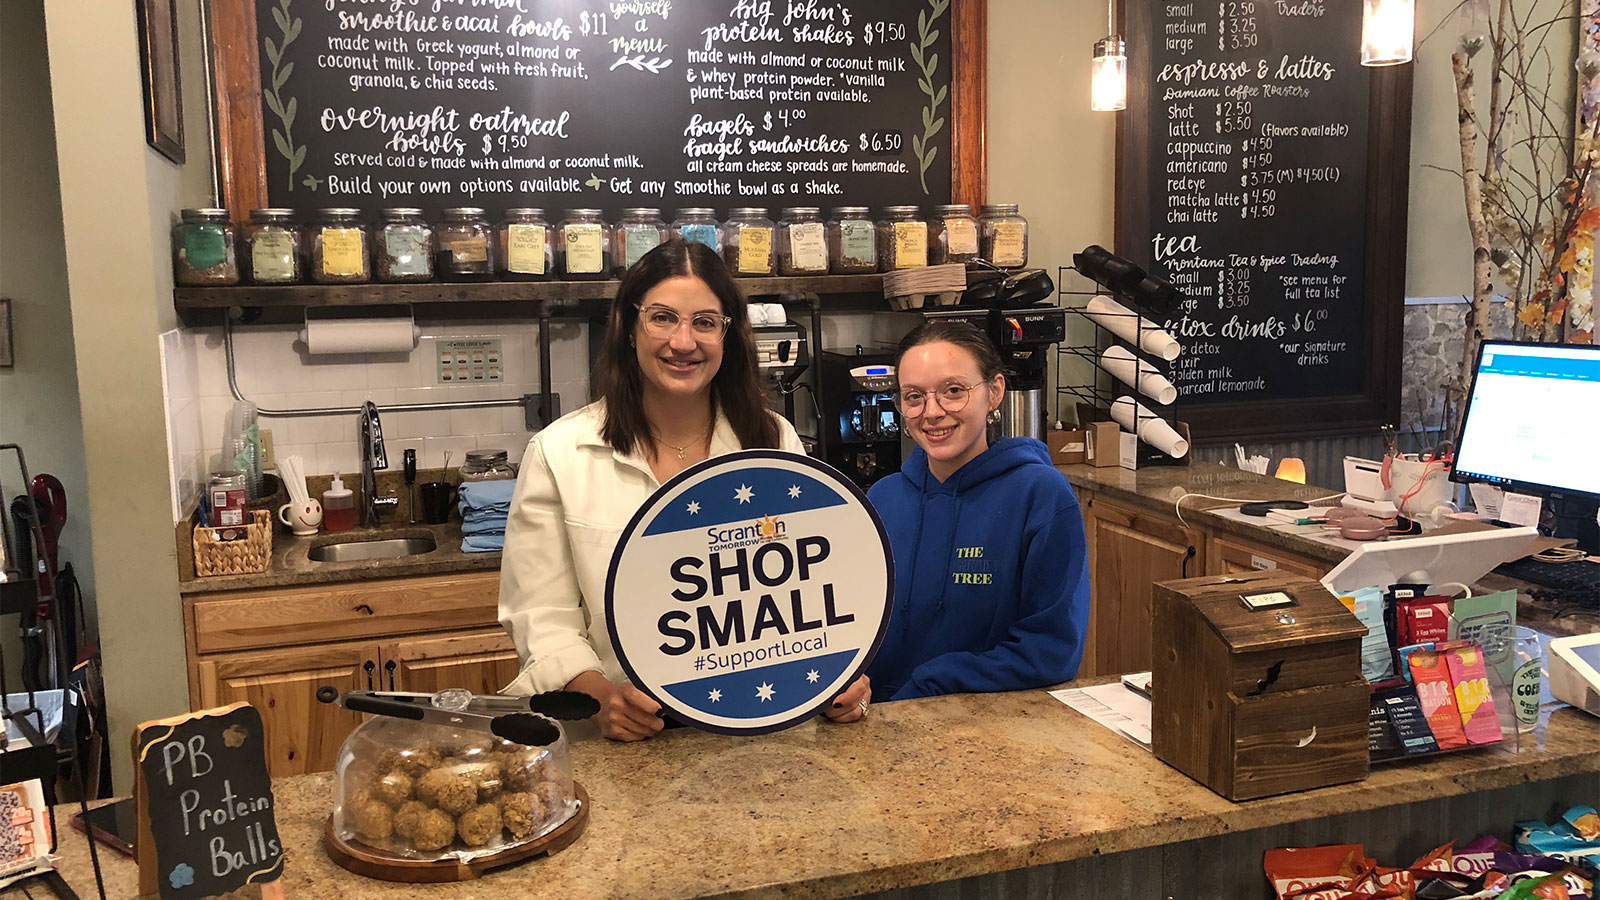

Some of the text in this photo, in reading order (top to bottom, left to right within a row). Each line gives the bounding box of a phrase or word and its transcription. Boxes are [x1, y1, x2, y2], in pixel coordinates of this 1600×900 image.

[609, 0, 672, 20] yourself
[729, 0, 775, 25] big
[1274, 1, 1326, 17] Traders
[338, 10, 608, 41] smoothie & acai bowls $11
[635, 18, 649, 32] a
[1165, 20, 1207, 35] medium
[700, 20, 906, 51] protein shakes $9.50
[328, 34, 581, 59] made with Greek yogurt, almond or
[608, 36, 669, 55] menu
[1166, 37, 1193, 55] large
[318, 53, 379, 71] coconut
[385, 56, 421, 71] milk.
[425, 55, 474, 76] Topped
[480, 61, 510, 75] with
[514, 61, 548, 77] fresh
[687, 48, 906, 72] made with almond or coconut milk
[686, 67, 835, 89] & whey protein powder.
[1157, 54, 1336, 86] espresso & lattes
[349, 73, 498, 92] granola, & chia seeds.
[690, 85, 871, 104] plant-based protein available.
[1163, 84, 1310, 101] Damiani Coffee Roasters
[321, 105, 570, 139] overnight oatmeal
[683, 113, 755, 142] bagels
[1169, 122, 1199, 137] latte
[1261, 123, 1298, 136] (flavors
[1301, 123, 1349, 137] available)
[385, 130, 467, 156] bowls
[683, 137, 743, 161] bagel
[748, 134, 850, 154] sandwiches
[1167, 142, 1232, 161] cappuccino
[386, 155, 415, 167] cold
[418, 156, 428, 169] &
[431, 157, 466, 169] made
[470, 157, 499, 170] with
[501, 156, 546, 169] almond
[549, 159, 561, 169] or
[565, 153, 610, 168] coconut
[613, 154, 644, 169] milk.
[686, 159, 909, 174] all cream cheese spreads are homemade.
[1166, 160, 1228, 173] americano
[328, 175, 582, 199] Build your own options available.
[610, 177, 633, 194] Get
[640, 180, 666, 198] any
[674, 178, 731, 195] smoothie
[738, 179, 767, 195] bowl
[771, 182, 785, 194] as
[790, 182, 799, 194] a
[1168, 193, 1210, 207] matcha
[1214, 194, 1240, 207] latte
[1167, 209, 1189, 223] chai
[1193, 209, 1218, 223] latte
[1151, 232, 1202, 262] tea
[1228, 253, 1249, 267] Tea
[1250, 255, 1258, 267] &
[1291, 253, 1339, 268] Trading
[1302, 275, 1329, 286] menu
[1332, 274, 1347, 285] for
[1175, 285, 1213, 297] edium
[1285, 286, 1340, 300] full tea list
[1222, 315, 1287, 341] drinks
[1191, 341, 1220, 355] detox
[1297, 354, 1329, 366] drinks
[1208, 366, 1232, 380] milk
[1218, 376, 1266, 393] lemonade
[709, 538, 760, 552] TOMORROW
[956, 546, 984, 558] THE
[670, 536, 831, 602] SHOP
[952, 572, 993, 585] TREE
[657, 583, 855, 656] SMALL
[693, 632, 828, 672] #SupportLocal
[163, 734, 214, 786] PB
[180, 779, 269, 836] Protein
[209, 822, 280, 877] Balls
